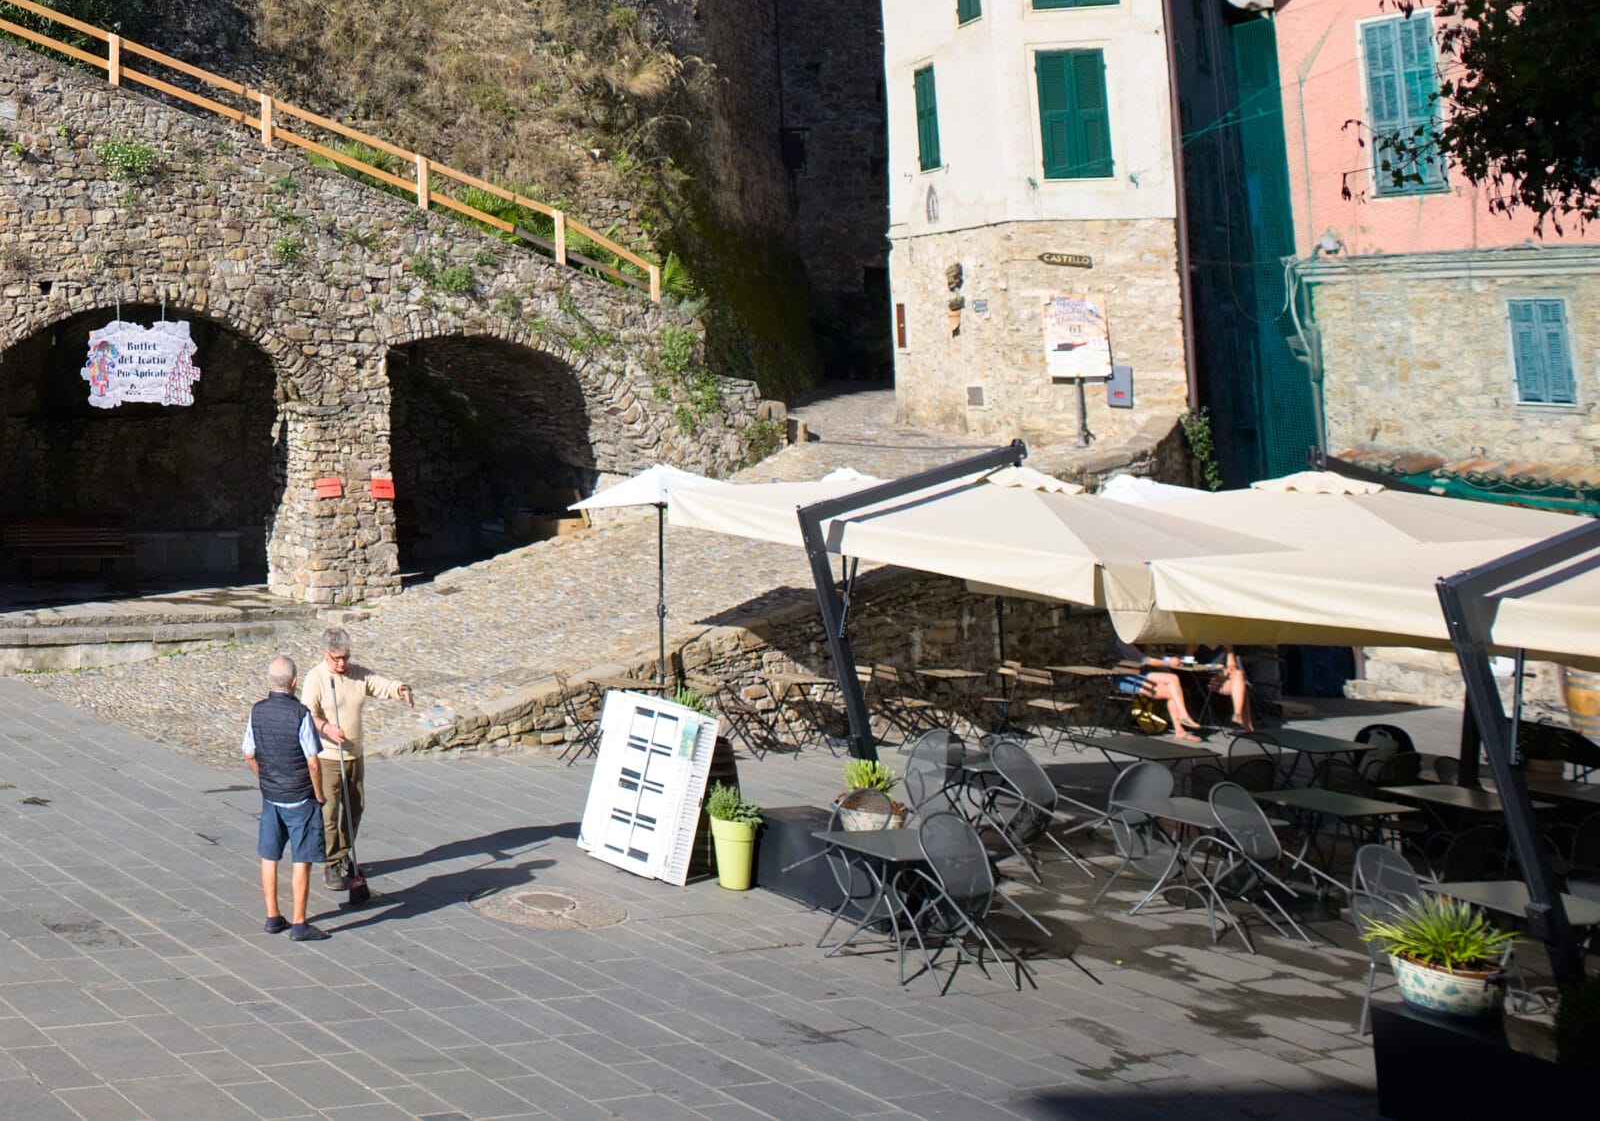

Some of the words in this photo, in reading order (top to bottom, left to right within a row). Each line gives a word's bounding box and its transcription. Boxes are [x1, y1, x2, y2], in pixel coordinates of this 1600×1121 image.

[1043, 253, 1090, 265] CASTELLO
[127, 341, 157, 351] Buffet
[118, 355, 133, 364] del
[138, 355, 166, 364] Teatro
[117, 369, 131, 377] Pro
[133, 369, 168, 379] Apricale
